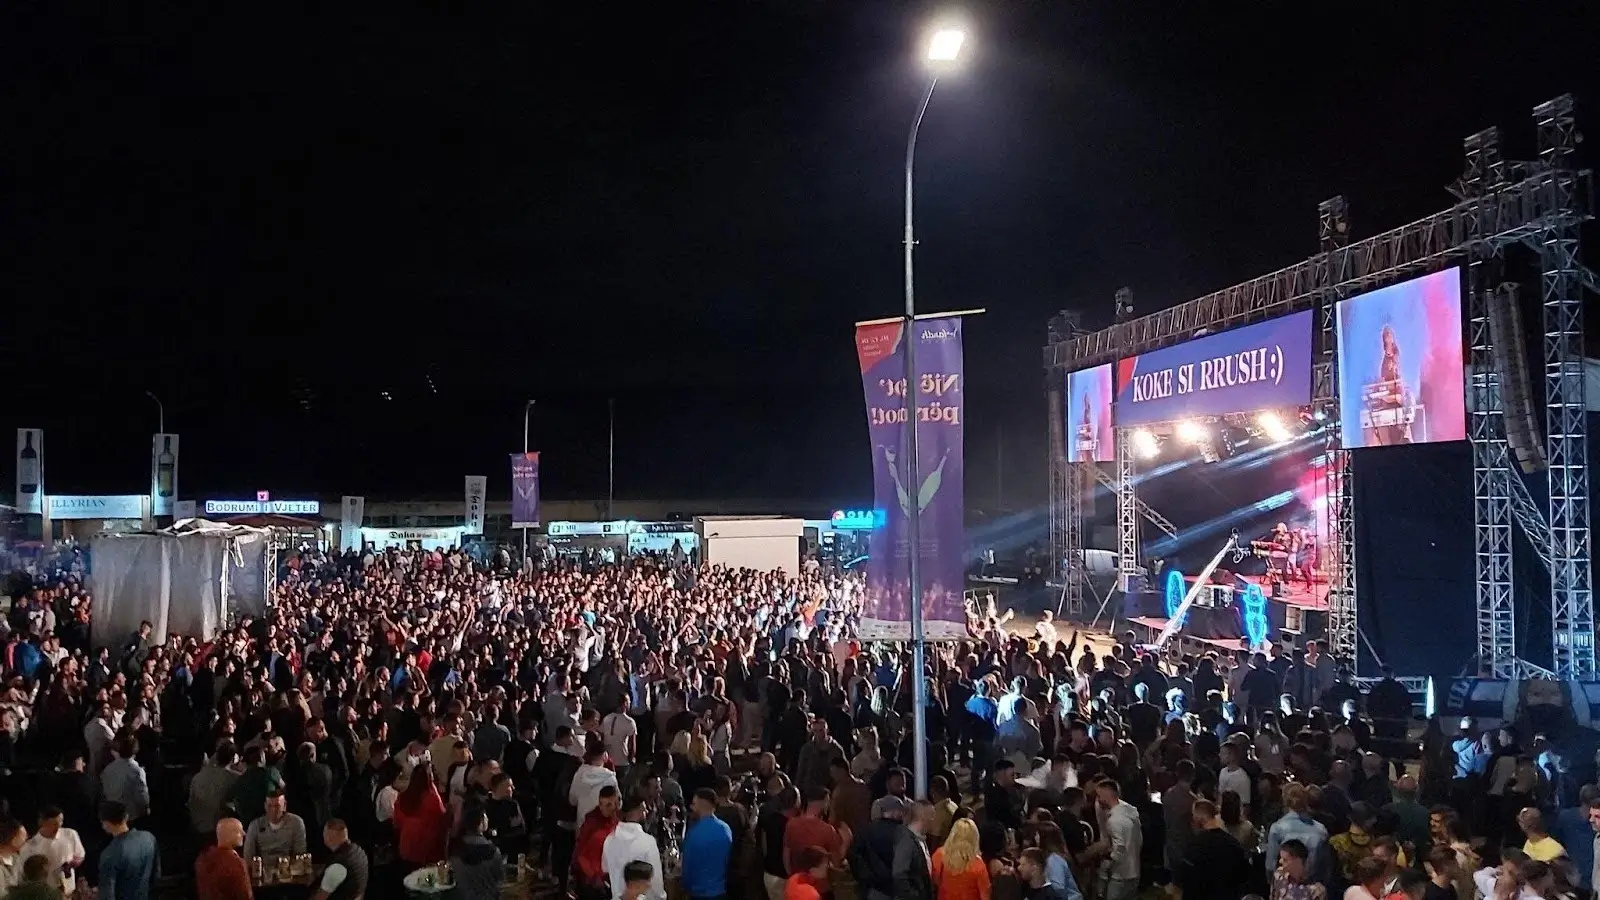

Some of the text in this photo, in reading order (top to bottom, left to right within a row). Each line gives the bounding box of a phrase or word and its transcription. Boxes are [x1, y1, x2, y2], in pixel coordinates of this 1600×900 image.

[1132, 369, 1173, 402] KOKE
[1178, 364, 1194, 394] SI
[51, 499, 106, 508] ILLYRIAN
[207, 502, 259, 512] BODRUMI
